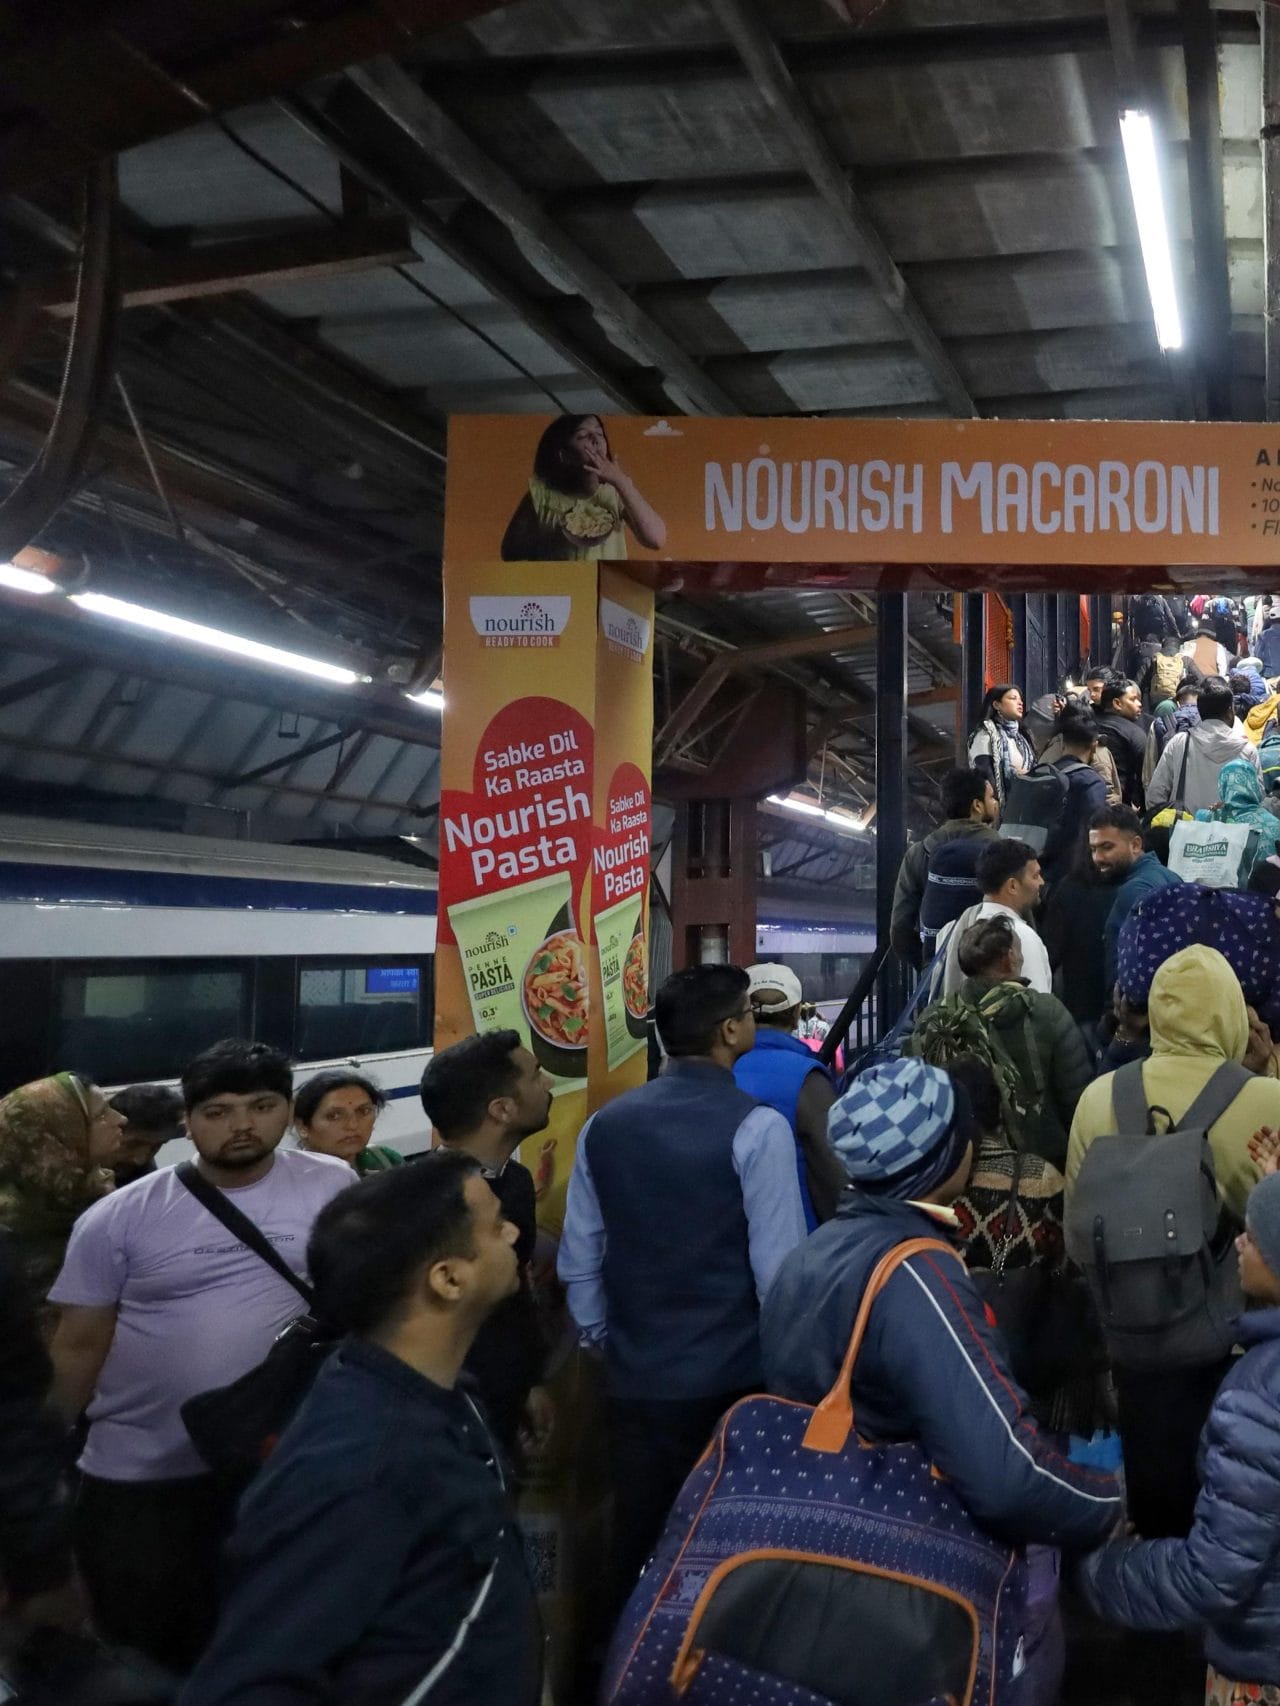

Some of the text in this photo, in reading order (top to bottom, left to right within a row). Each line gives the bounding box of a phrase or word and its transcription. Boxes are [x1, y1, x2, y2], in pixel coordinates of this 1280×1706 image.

[1255, 449, 1271, 467] A
[705, 457, 1219, 536] NOURISH MACARONI
[485, 613, 555, 633] nourish
[608, 621, 644, 650] nourish
[485, 636, 554, 647] READY TO COOK
[484, 729, 578, 773] Sabke Dil
[485, 758, 585, 798] Ka Raasta
[610, 790, 646, 815] Sabke Dil
[443, 785, 591, 853] Nourish
[610, 810, 648, 834] Ka Raasta
[471, 834, 577, 886] Pasta
[593, 830, 649, 875] Nourish
[604, 865, 645, 900] Pasta
[465, 935, 510, 959] nourish
[470, 963, 513, 992] PASTA
